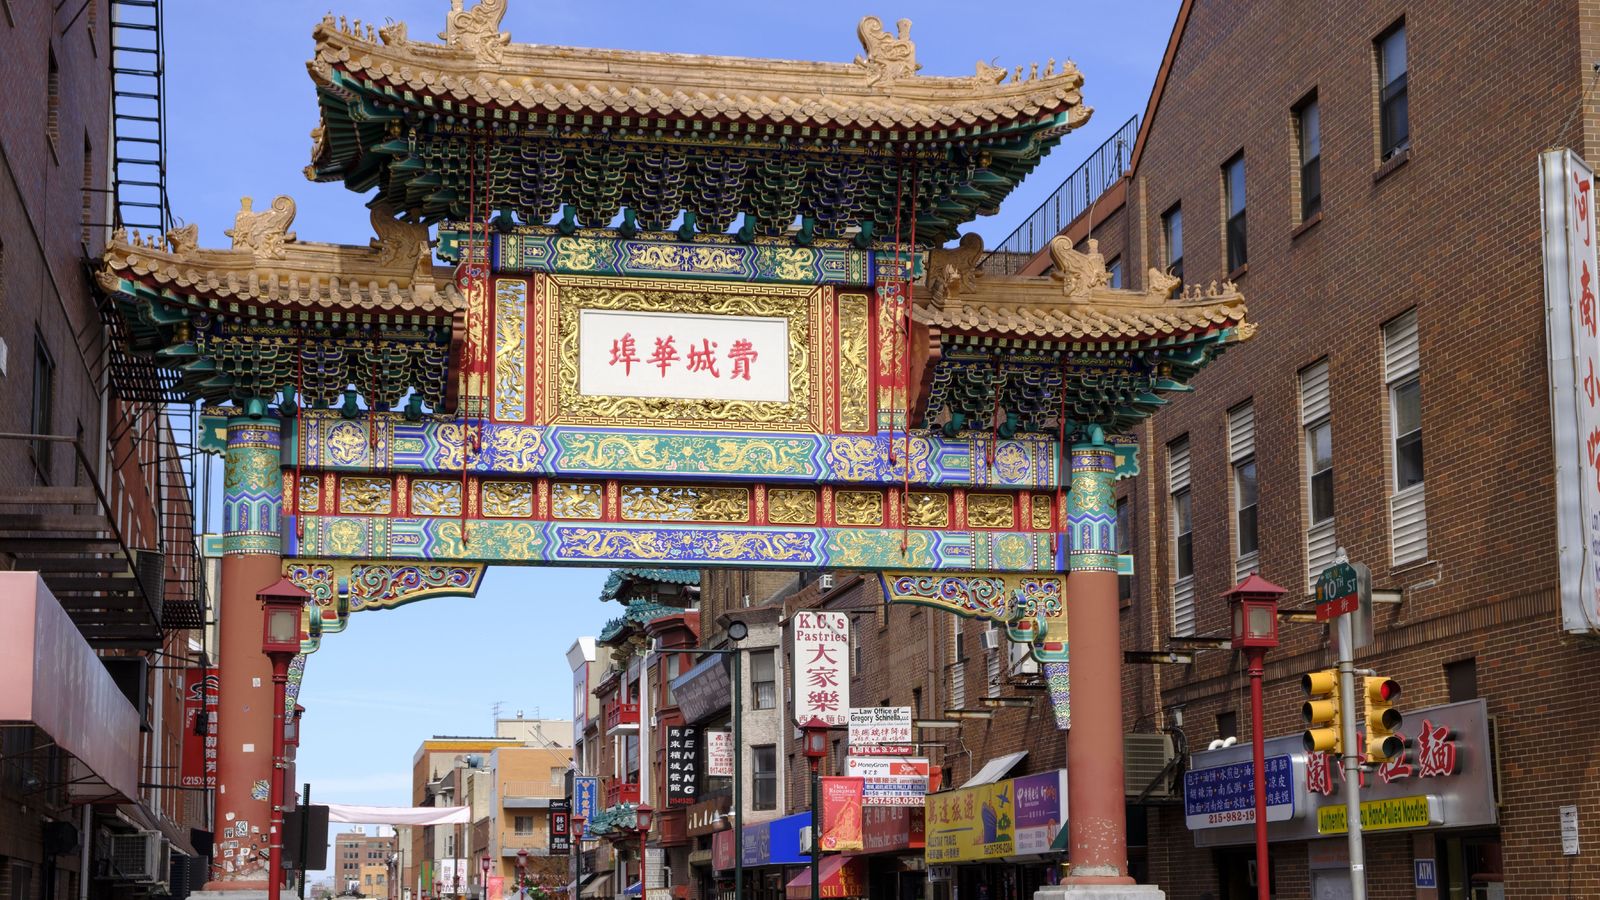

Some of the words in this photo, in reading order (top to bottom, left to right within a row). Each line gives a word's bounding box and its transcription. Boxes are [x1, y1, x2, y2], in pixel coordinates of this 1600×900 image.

[1347, 578, 1356, 592] ST
[798, 613, 845, 630] K.C.'s
[796, 630, 848, 642] Pastries
[806, 643, 839, 713] 大家樂
[850, 714, 873, 723] Gregory
[683, 728, 695, 794] PENANG
[867, 797, 925, 805] 267.519.0204
[1368, 801, 1402, 825] Hand-Pulled
[1403, 798, 1428, 822] Noodles
[931, 867, 951, 878] ATM
[1418, 862, 1433, 880] ATM
[822, 885, 839, 897] SIU
